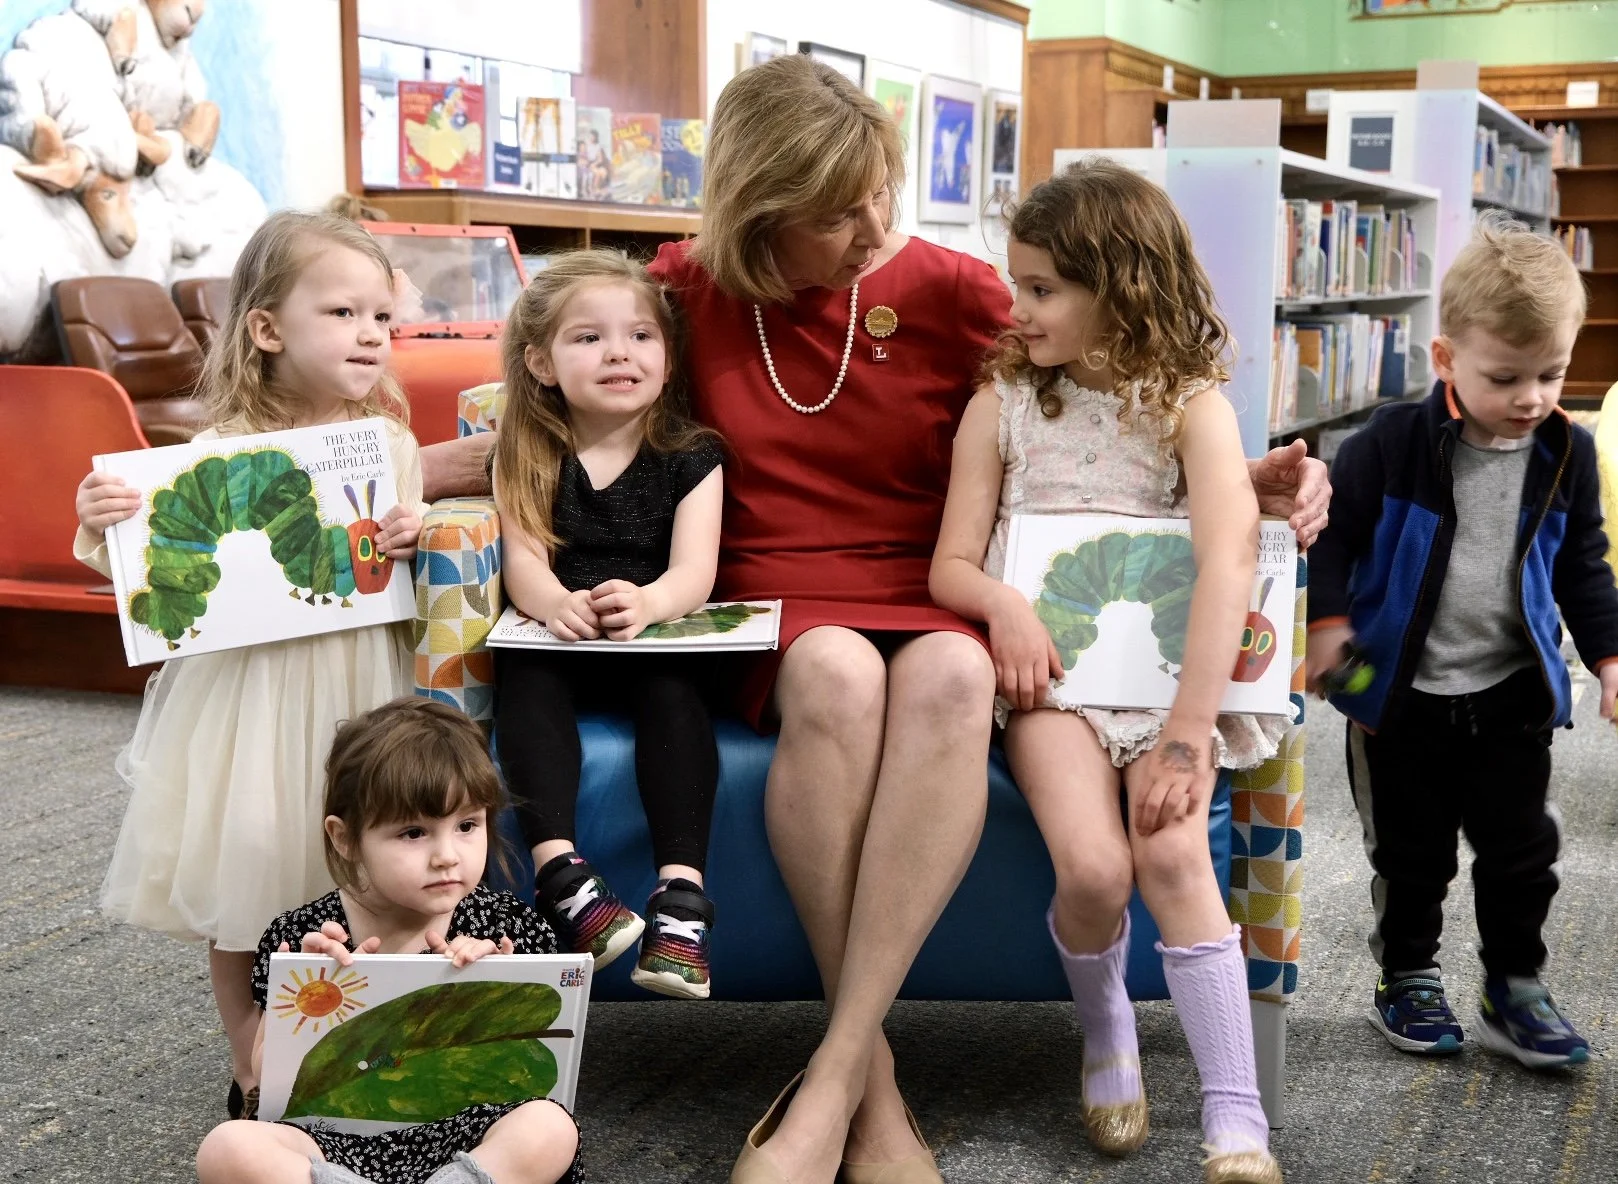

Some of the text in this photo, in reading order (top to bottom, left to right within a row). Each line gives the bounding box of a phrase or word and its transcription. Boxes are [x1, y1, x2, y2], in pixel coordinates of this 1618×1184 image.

[875, 346, 887, 359] L
[323, 429, 378, 446] THE VERY
[333, 441, 381, 457] HUNGRY
[305, 453, 384, 473] CATERPILLAR
[341, 469, 385, 483] by Eric Carle
[1258, 531, 1288, 541] VERY
[1257, 542, 1288, 553] NGRY
[1255, 568, 1286, 576] ric Carle
[560, 979, 584, 987] CARLE
